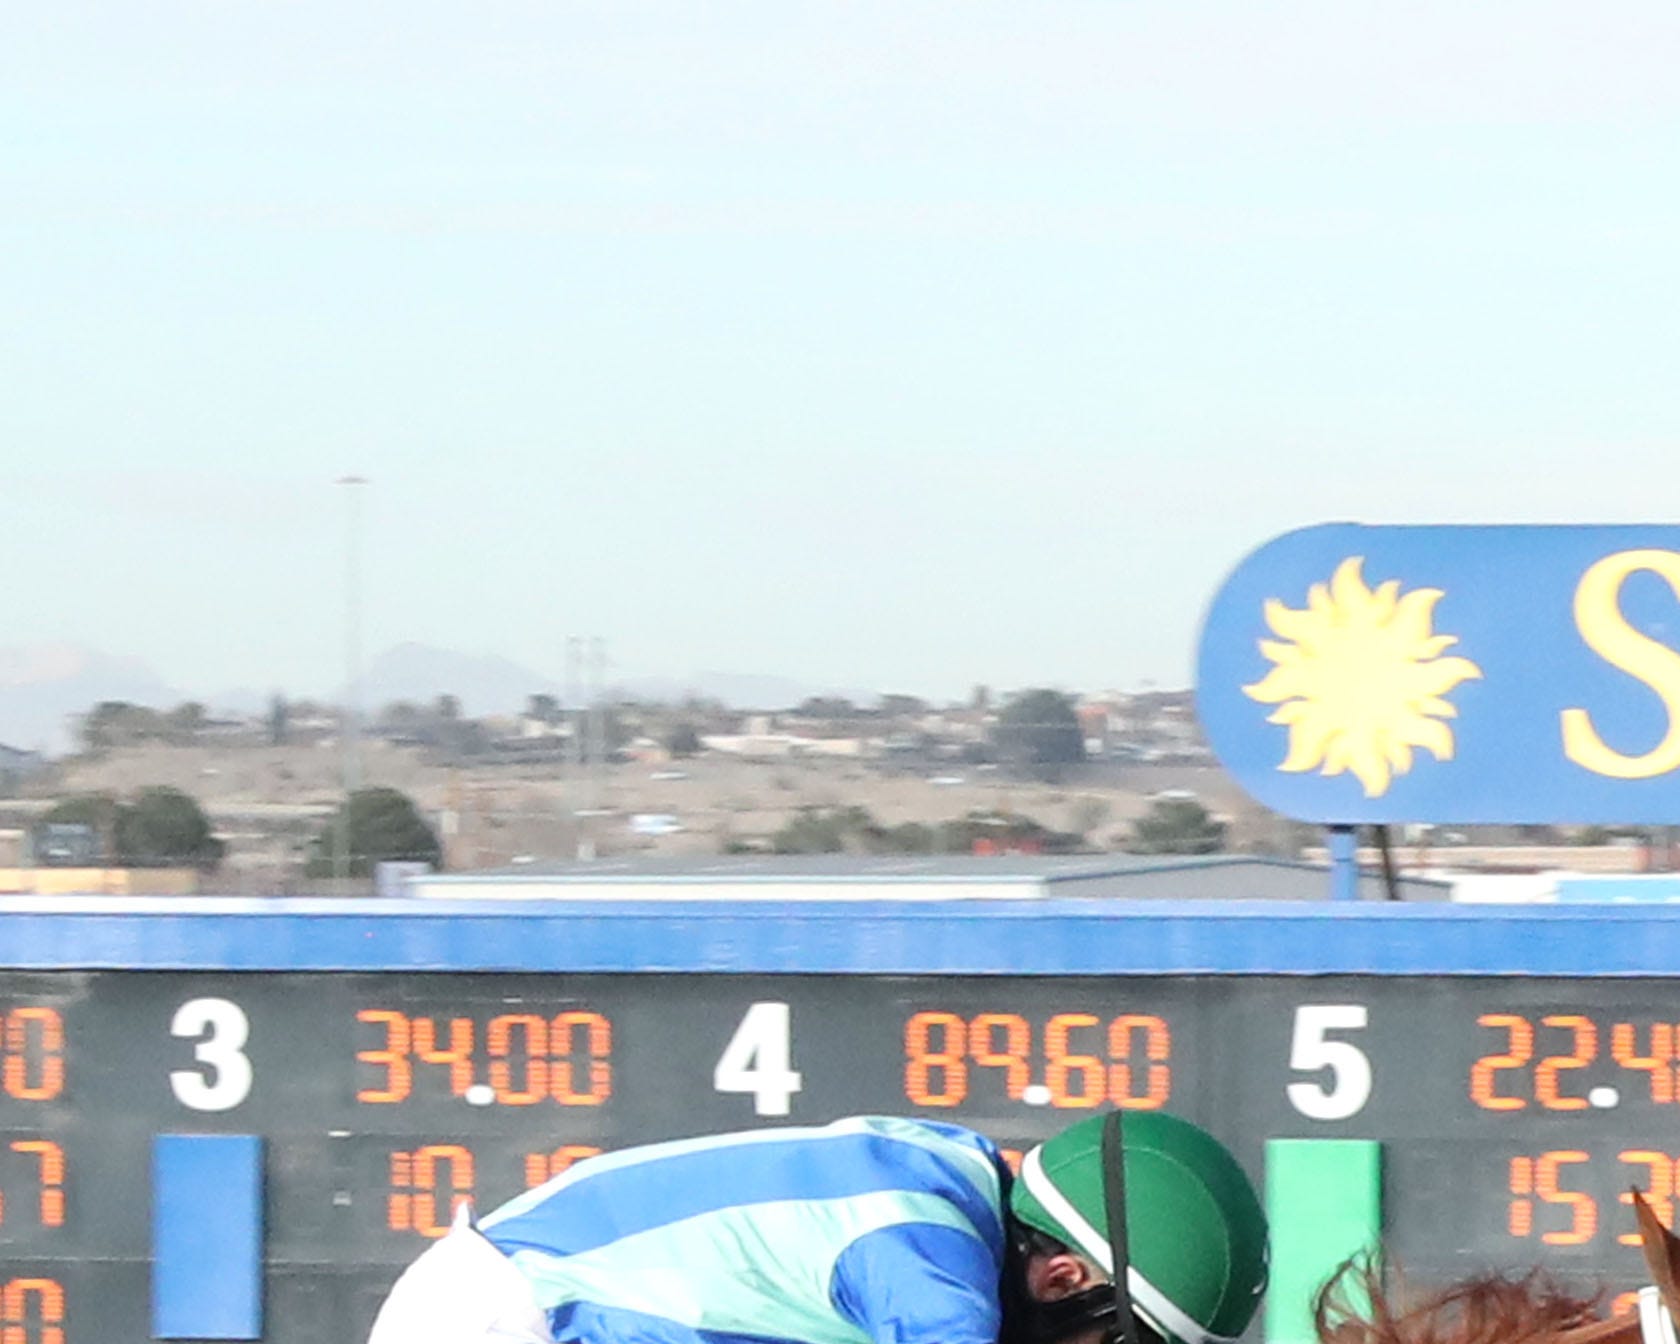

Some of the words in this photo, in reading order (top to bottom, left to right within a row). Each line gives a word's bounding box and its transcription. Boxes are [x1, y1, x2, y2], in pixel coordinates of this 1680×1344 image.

[170, 997, 253, 1111] 3
[355, 1009, 612, 1106] 34.00
[714, 1002, 802, 1115] 4
[904, 1011, 1171, 1110] 89.60
[1286, 1005, 1373, 1120] 5
